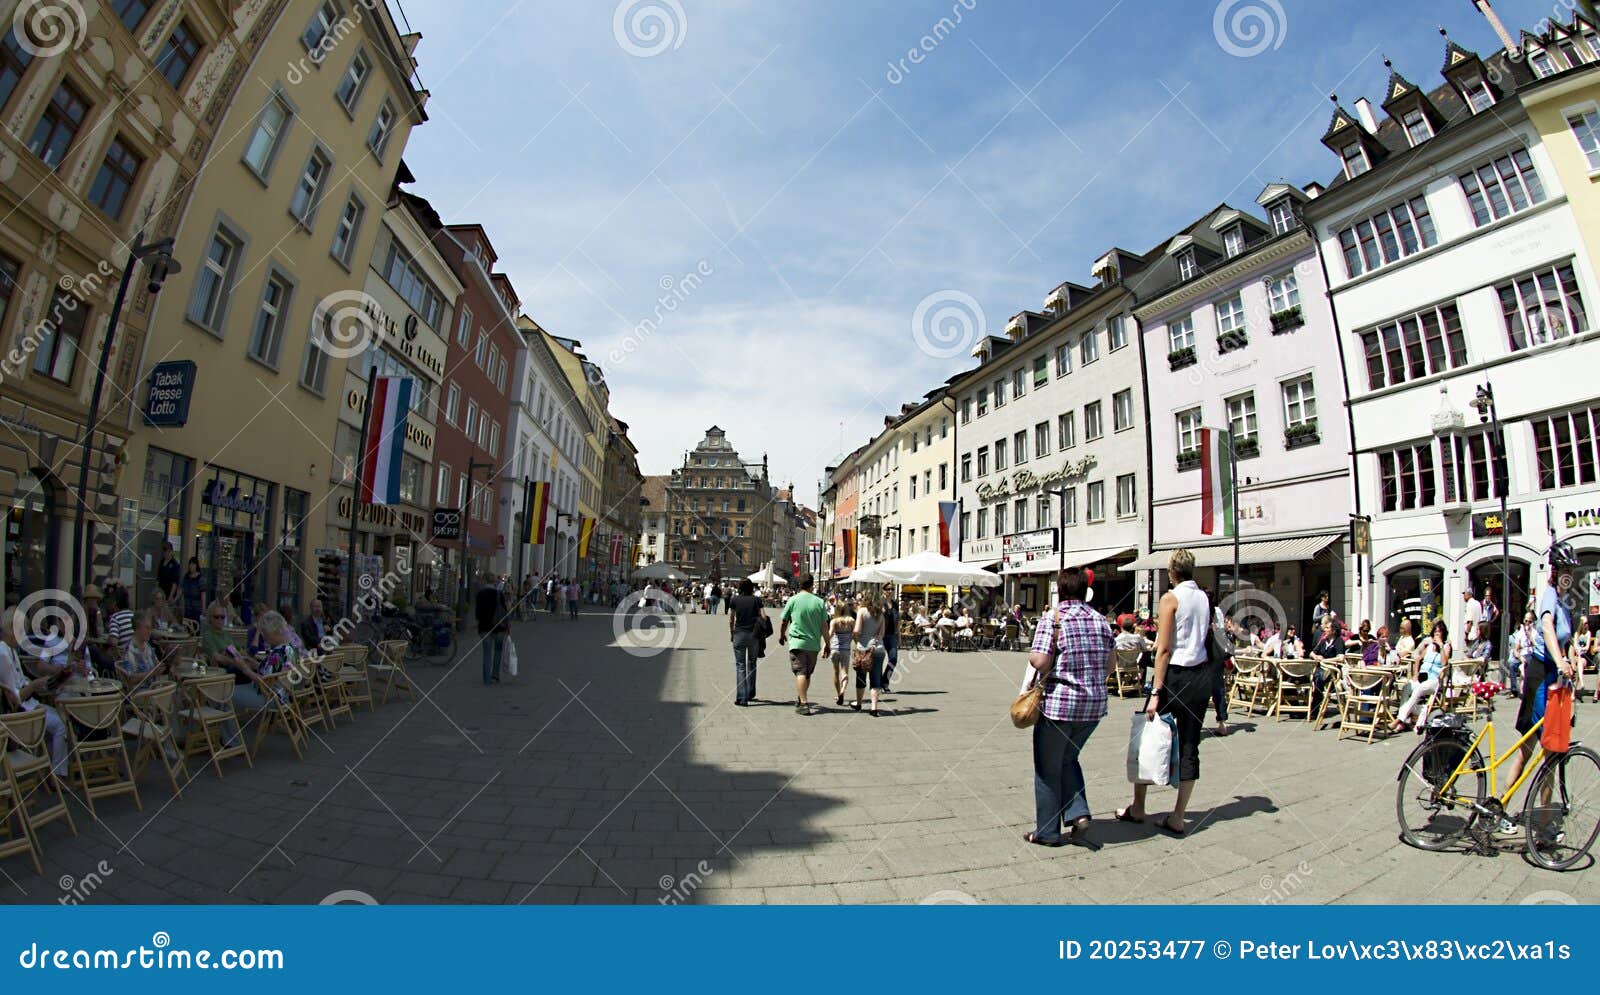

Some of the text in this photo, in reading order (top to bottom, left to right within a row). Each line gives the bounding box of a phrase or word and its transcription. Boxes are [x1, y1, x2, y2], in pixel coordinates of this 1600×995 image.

[155, 372, 184, 387] Tabak
[150, 387, 183, 401] Presse
[150, 401, 176, 415] Lotto
[406, 421, 432, 450] HOTO
[433, 526, 459, 536] HEPP
